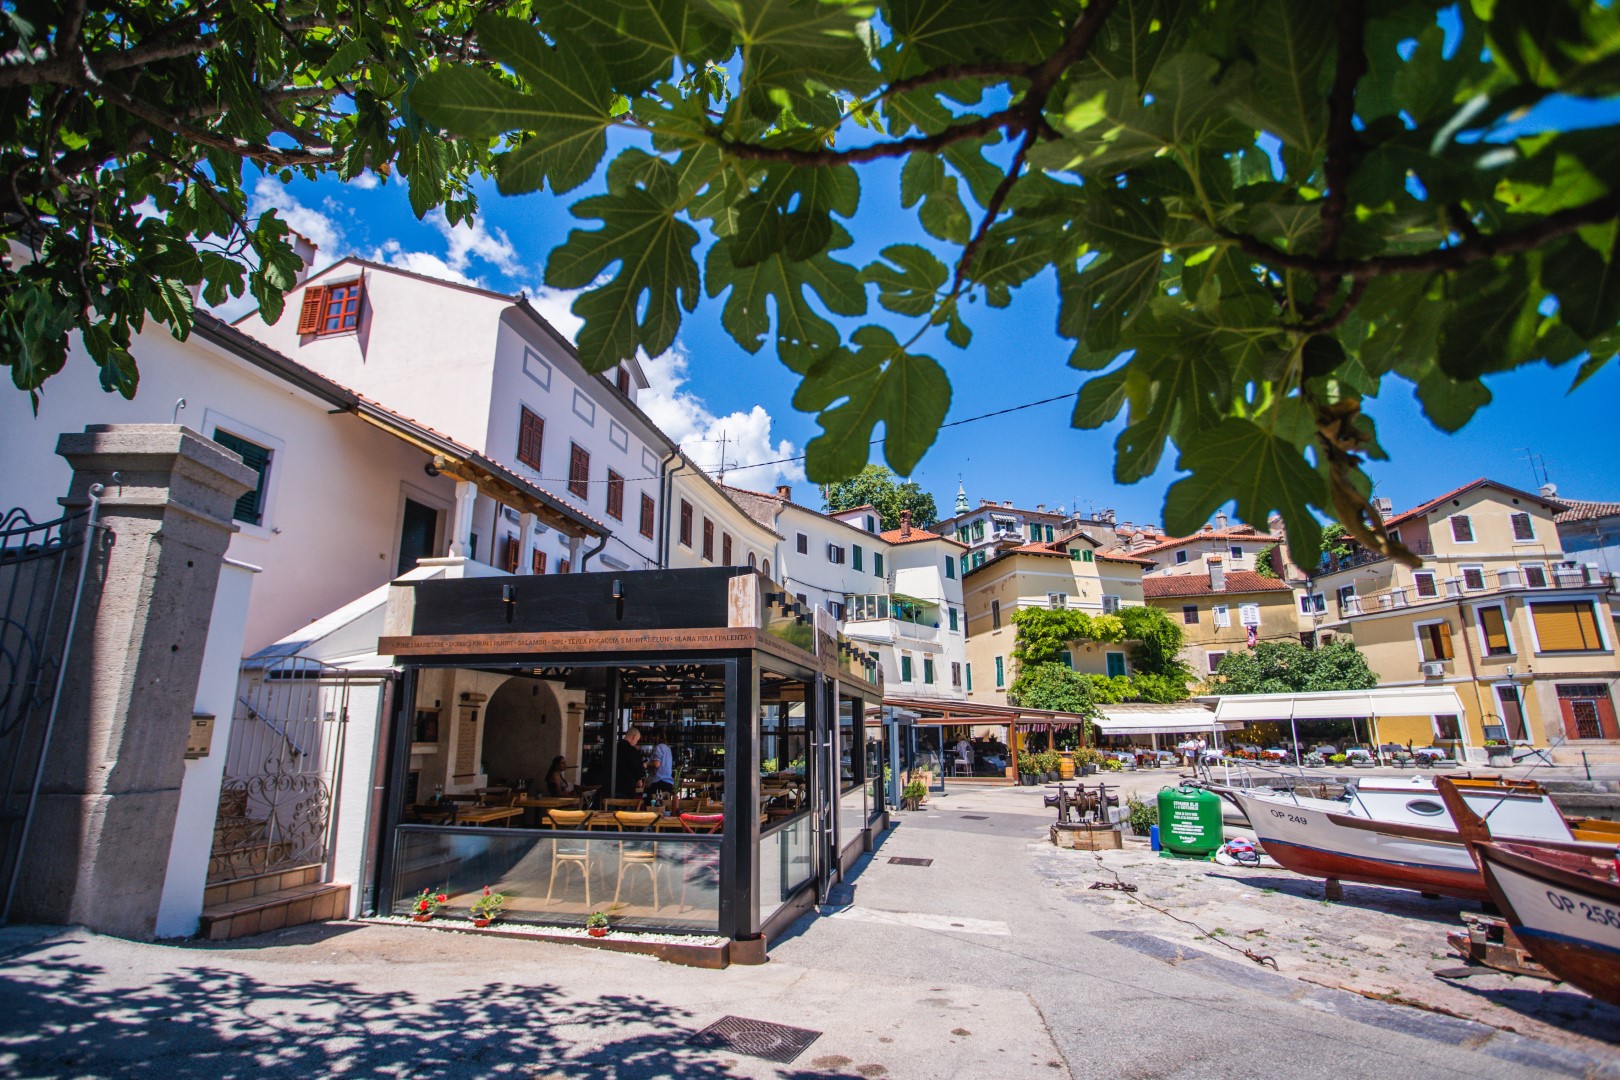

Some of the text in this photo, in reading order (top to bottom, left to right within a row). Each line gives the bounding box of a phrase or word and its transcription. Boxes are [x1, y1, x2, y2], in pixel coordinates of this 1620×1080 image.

[1270, 809, 1308, 825] OP 249
[1546, 890, 1620, 930] OP 256
